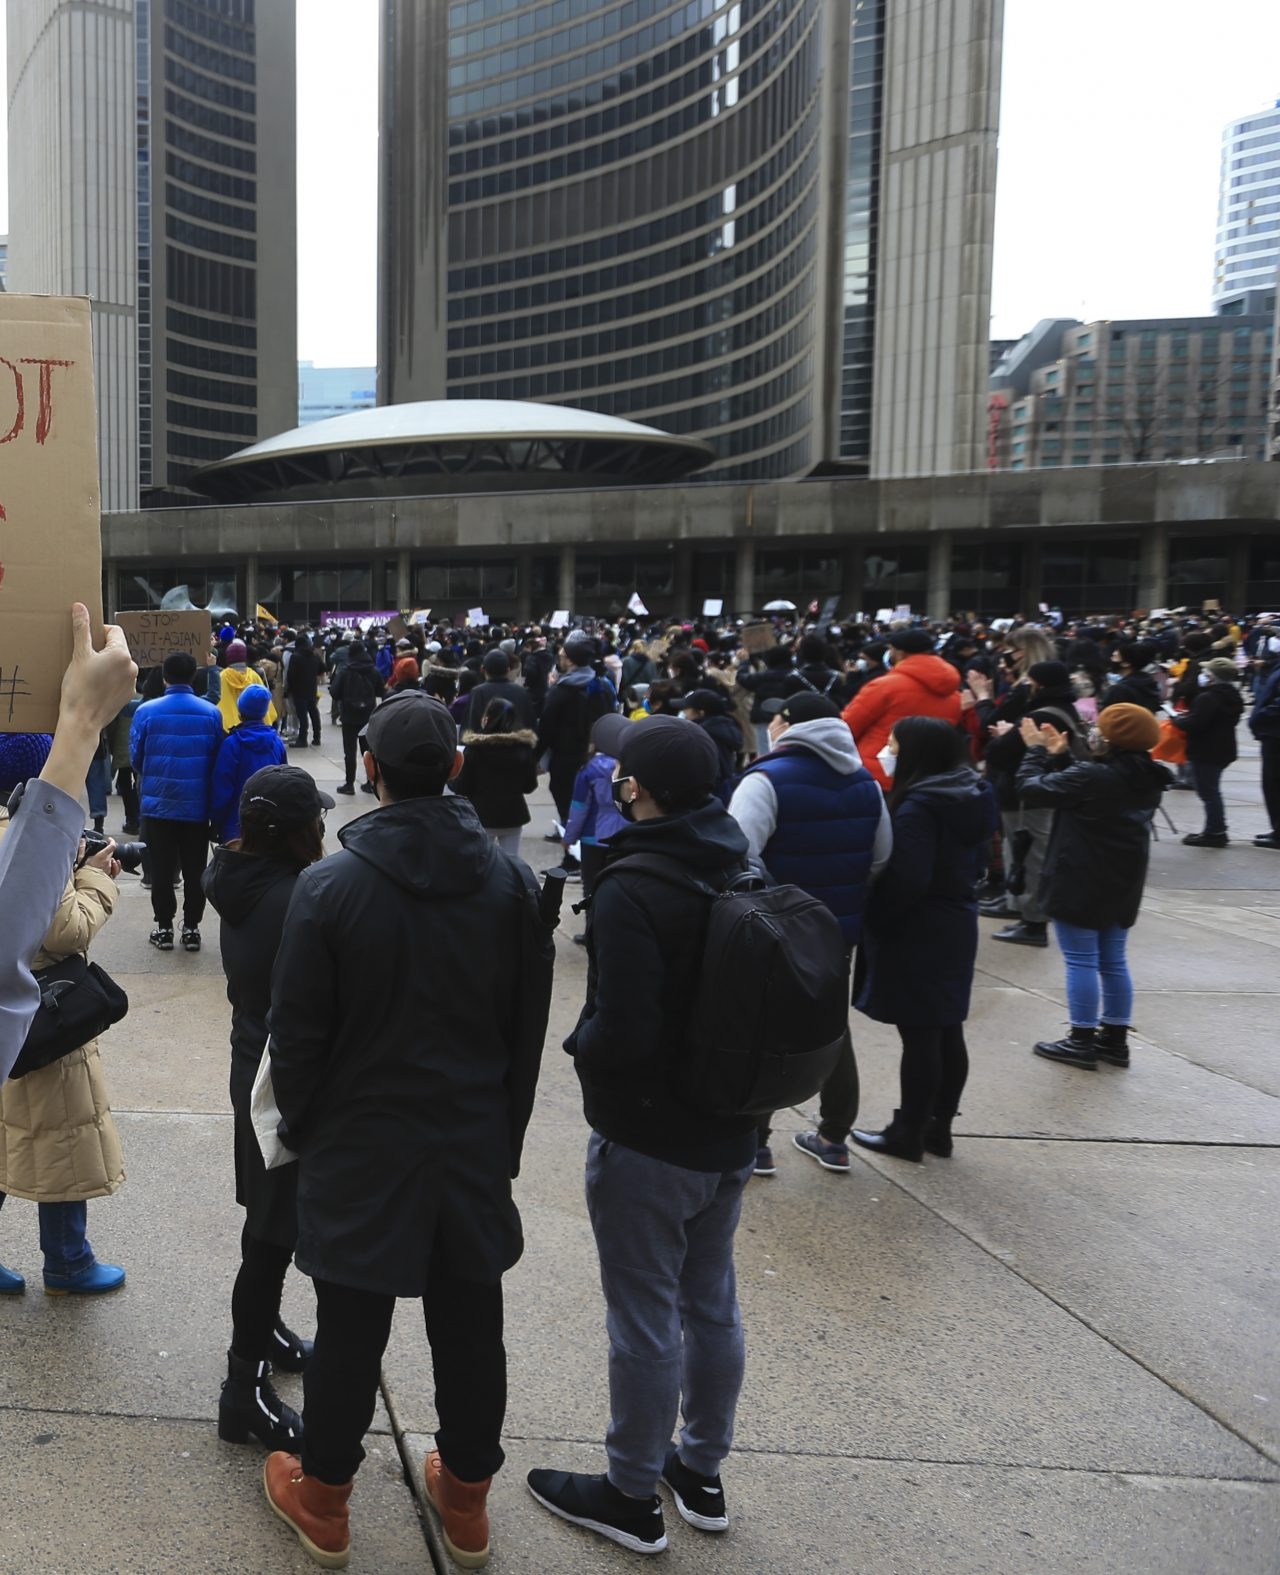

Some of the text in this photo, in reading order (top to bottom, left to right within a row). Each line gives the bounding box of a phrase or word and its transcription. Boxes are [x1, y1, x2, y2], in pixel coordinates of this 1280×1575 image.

[140, 613, 180, 628] STOP
[357, 616, 391, 627] DWN
[130, 647, 194, 664] RACI!
